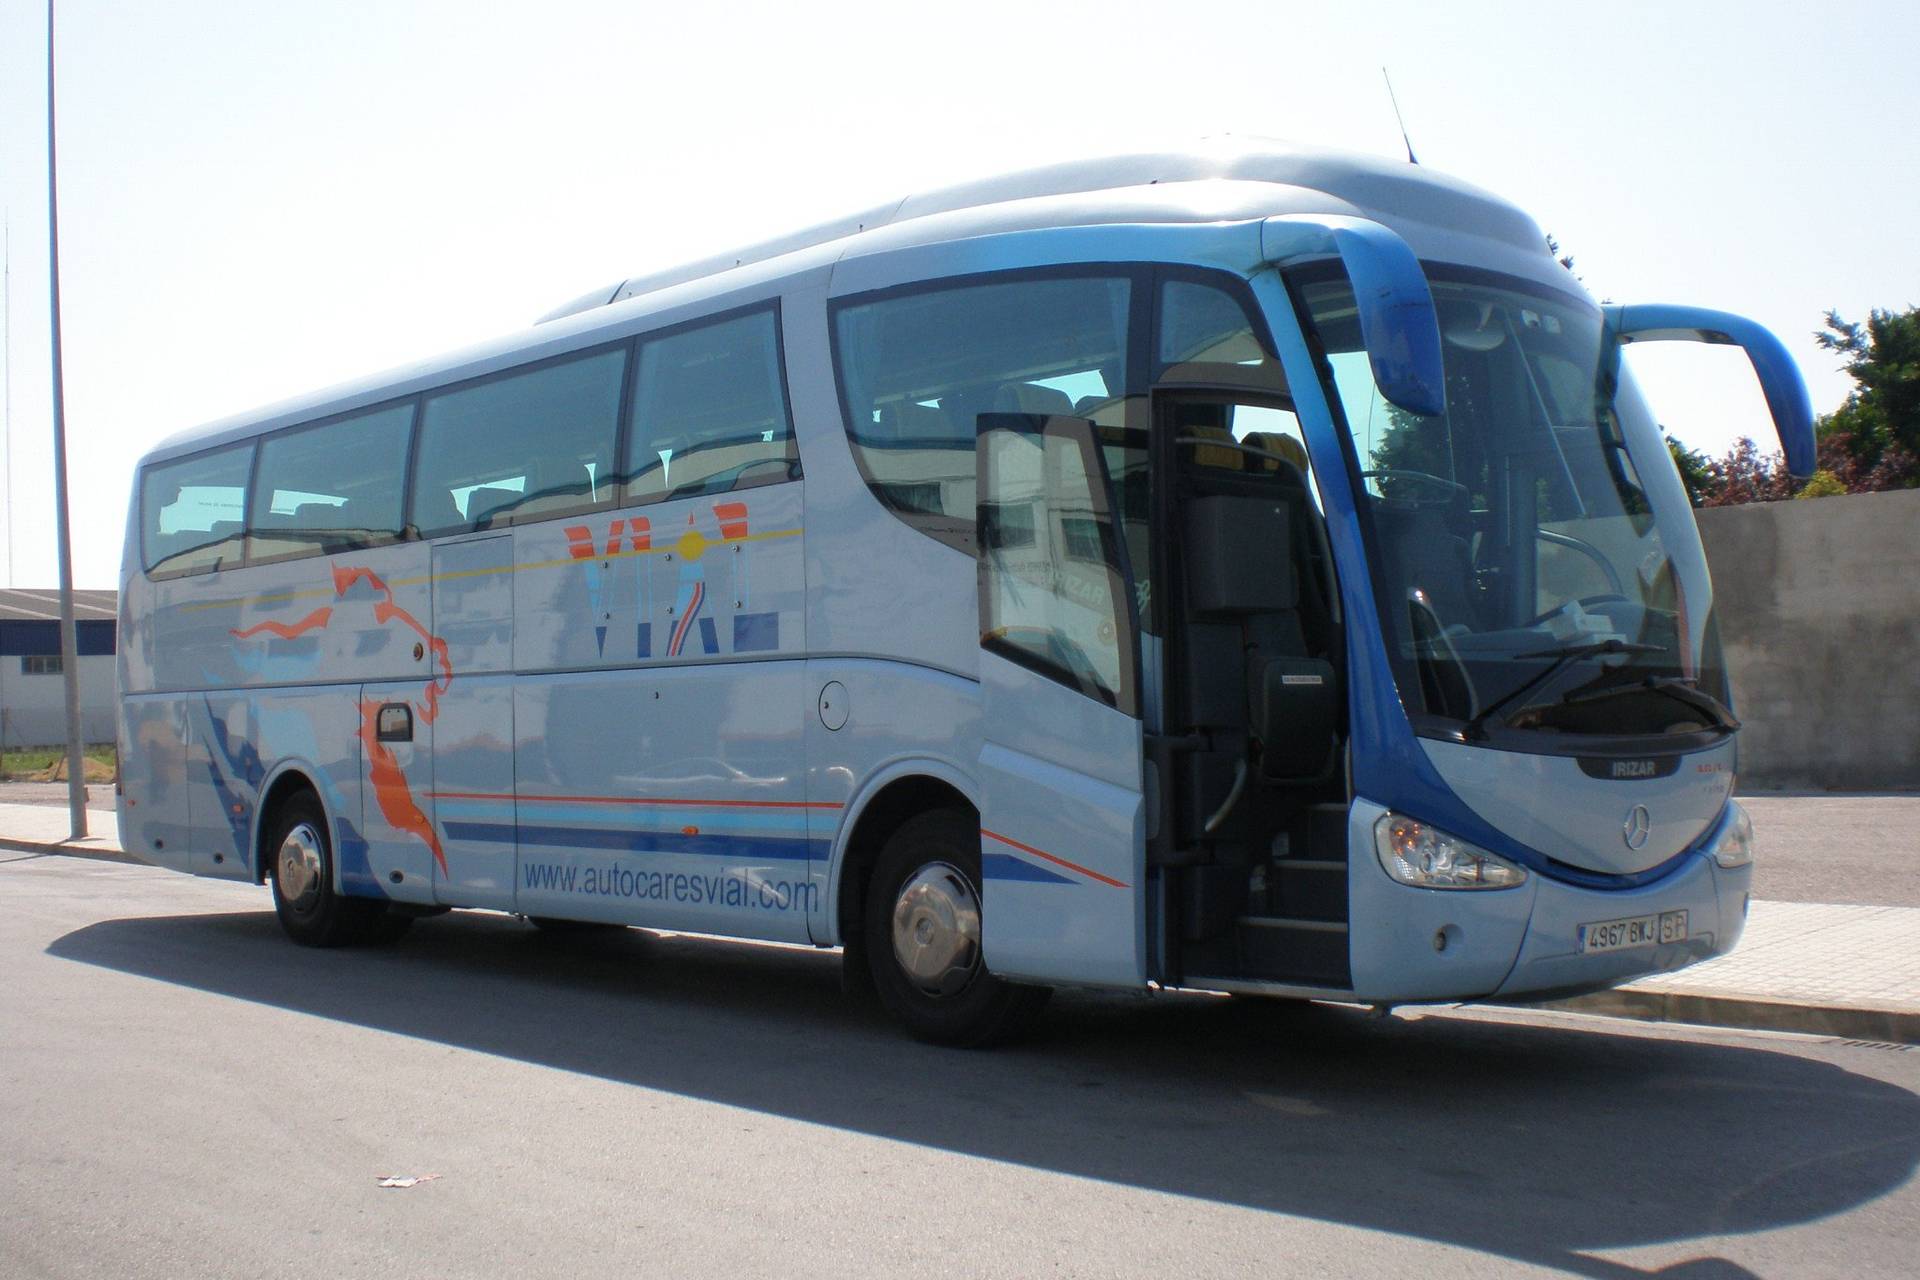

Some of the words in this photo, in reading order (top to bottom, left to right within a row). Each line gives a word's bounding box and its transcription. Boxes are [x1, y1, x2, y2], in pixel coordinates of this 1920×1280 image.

[1612, 760, 1657, 777] IRIZAR
[524, 861, 819, 913] www.autocaresvial.com
[1588, 923, 1626, 948] 4967
